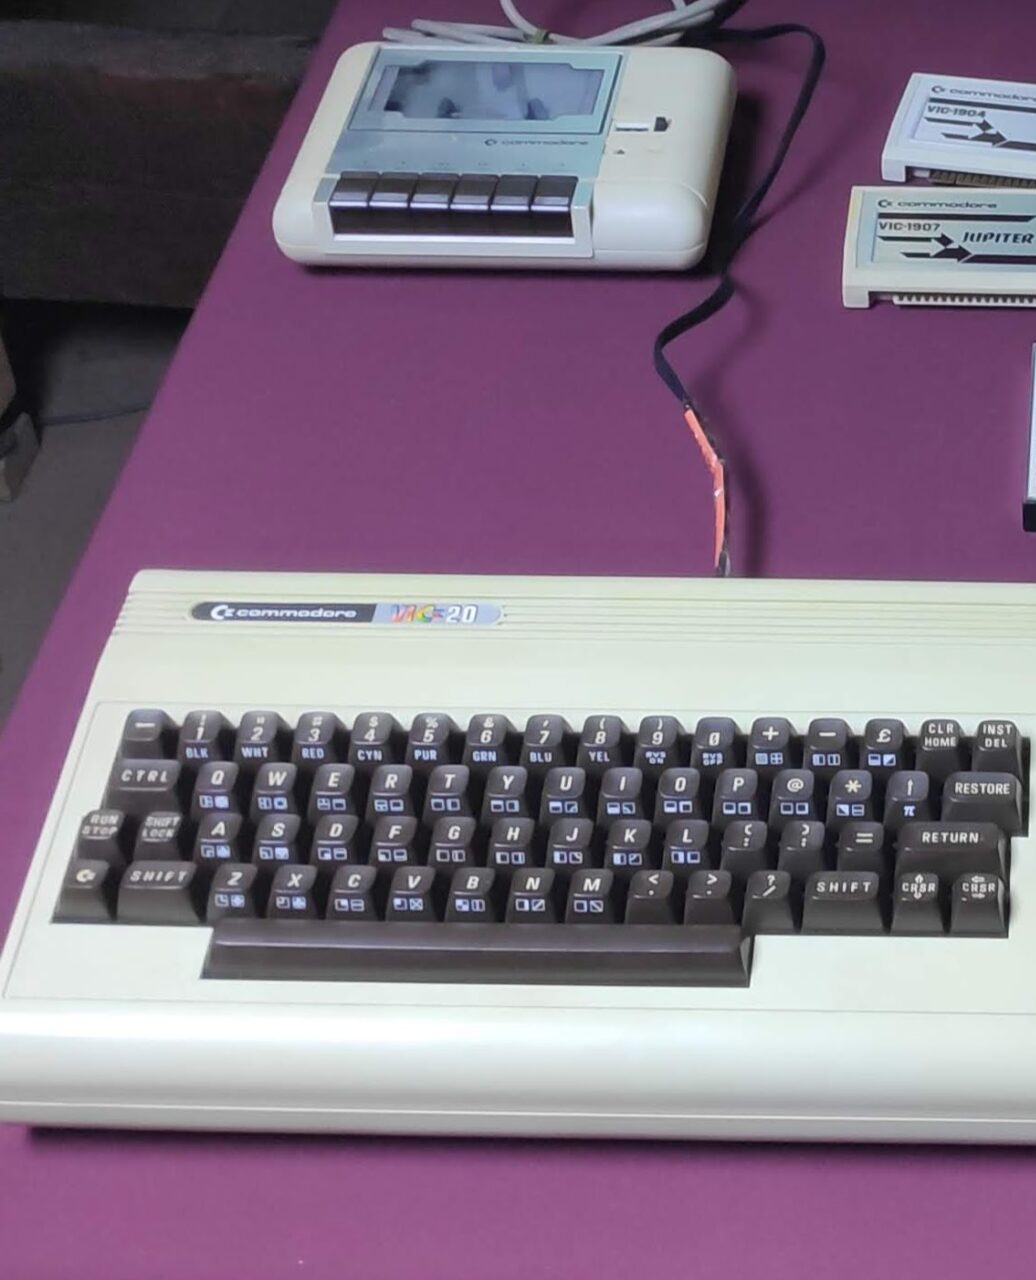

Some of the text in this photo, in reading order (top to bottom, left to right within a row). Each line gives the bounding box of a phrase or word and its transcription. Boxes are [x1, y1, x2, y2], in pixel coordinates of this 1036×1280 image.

[927, 105, 987, 118] VIC-1904
[897, 200, 998, 209] commodore
[879, 221, 941, 232] VIC-1907
[962, 231, 1035, 244] JUPITER
[235, 606, 357, 619] commodore
[250, 727, 263, 741] 2
[364, 729, 376, 741] 4
[928, 723, 954, 734] CLR
[983, 724, 1013, 735] INST
[308, 729, 320, 742] 3
[423, 730, 435, 743] 5
[480, 730, 492, 743] 6
[539, 730, 550, 744] 7
[595, 731, 606, 744] 8
[652, 732, 663, 744] 9
[876, 729, 891, 743] £
[924, 736, 956, 747] HOME
[985, 738, 1008, 748] DEL
[185, 747, 209, 759] BLK
[241, 746, 269, 758] WHT
[302, 747, 325, 759] RED
[357, 750, 382, 761] CYN
[414, 750, 437, 760] PUR
[472, 751, 496, 762] GRN
[529, 752, 552, 762] BLU
[589, 751, 610, 762] YEL
[121, 770, 168, 782] CTRL
[211, 770, 225, 785] Q
[268, 771, 287, 786] W
[328, 772, 341, 787] E
[385, 774, 398, 788] R
[444, 774, 456, 789] T
[503, 775, 515, 790] Y
[560, 776, 573, 791] U
[733, 777, 744, 792] P
[787, 778, 804, 792] @
[955, 782, 1010, 795] RESTORE
[91, 815, 117, 825] RUN
[145, 816, 181, 827] SHIFT
[82, 826, 118, 836] STOP
[142, 828, 174, 838] LOCK
[211, 821, 226, 836] A
[272, 823, 285, 837] S
[329, 823, 343, 838] D
[389, 825, 402, 839] F
[448, 825, 461, 840] G
[507, 827, 520, 841] H
[566, 827, 579, 841] J
[624, 828, 637, 842] K
[682, 829, 693, 842] L
[922, 832, 979, 843] RETURN
[130, 871, 187, 882] SHIFT
[228, 872, 242, 886] Z
[288, 873, 302, 887] X
[348, 874, 361, 887] C
[408, 875, 422, 889] V
[466, 876, 479, 890] B
[526, 877, 541, 890] N
[583, 878, 601, 892] M
[817, 881, 871, 893] SHIFT
[902, 882, 936, 893] CRSR
[962, 882, 996, 893] CRSR
